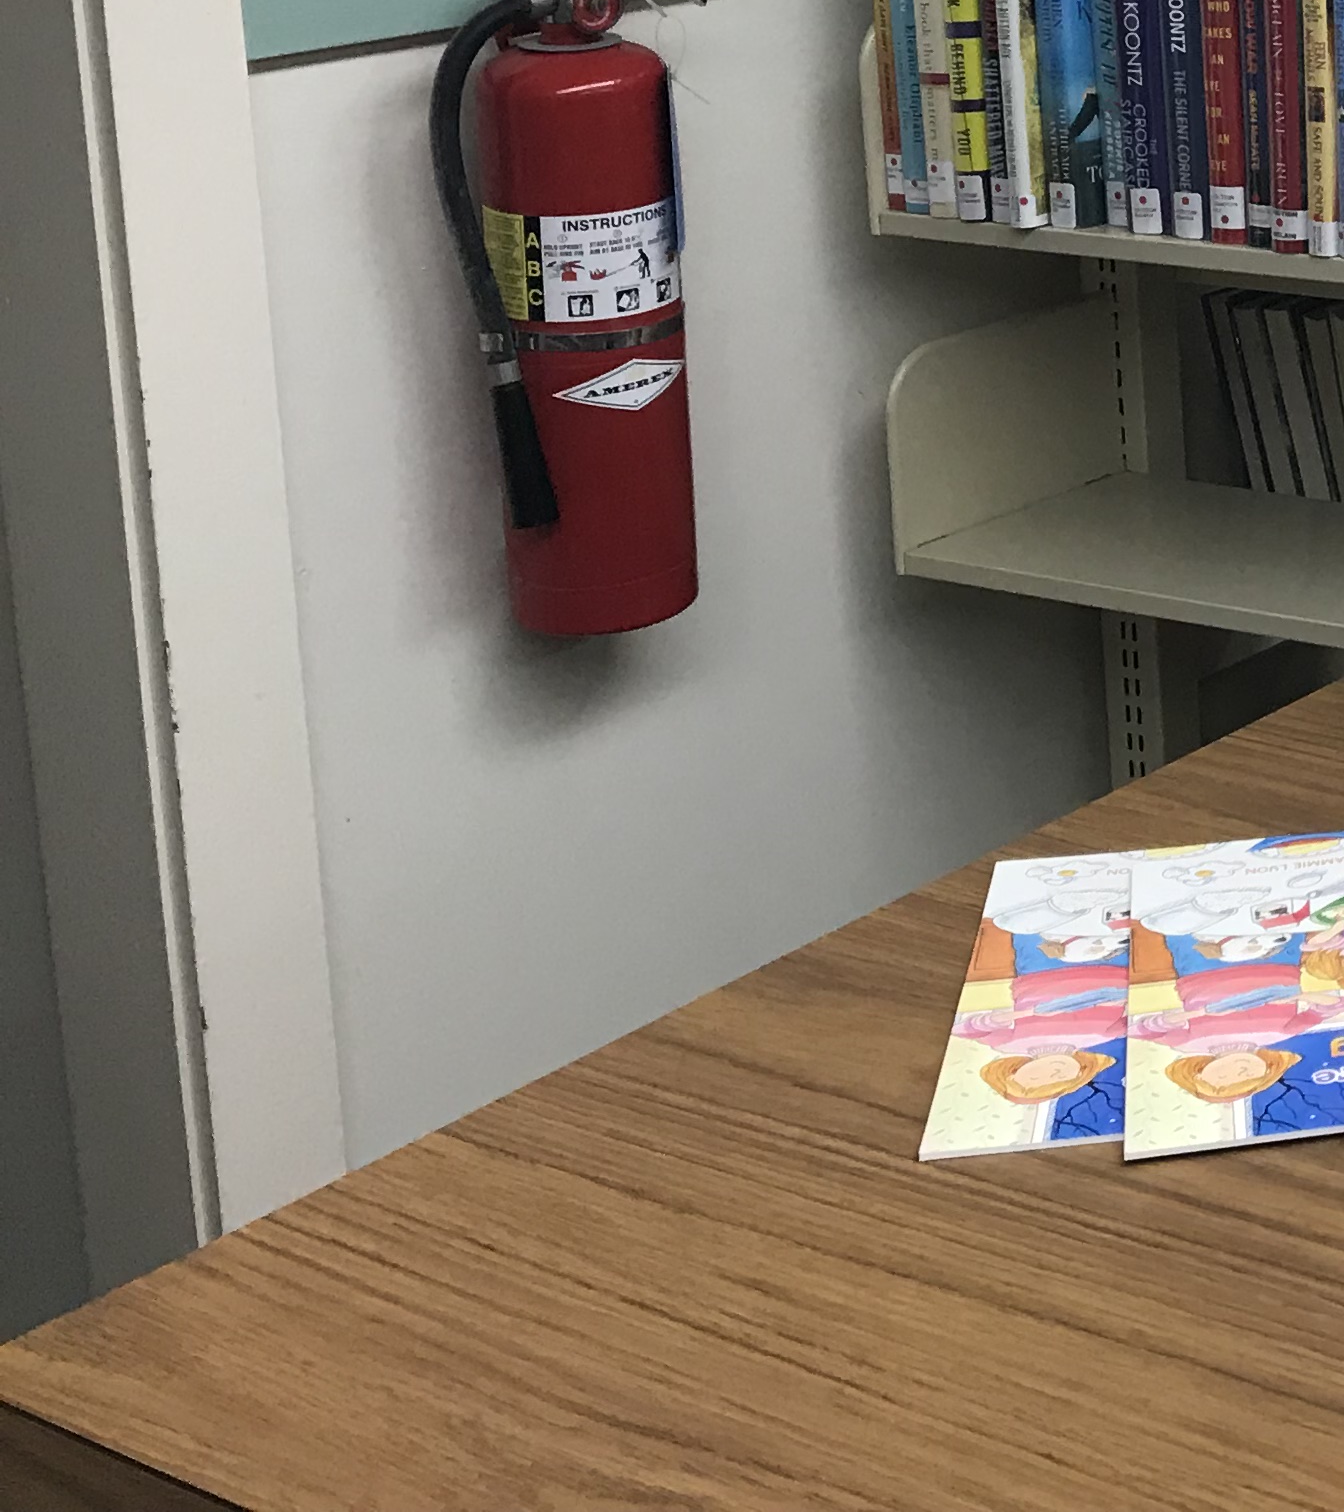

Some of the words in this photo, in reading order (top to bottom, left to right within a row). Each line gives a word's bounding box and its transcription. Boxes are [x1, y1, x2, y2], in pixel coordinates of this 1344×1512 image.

[1124, 2, 1143, 86] KOONTZ
[951, 44, 968, 96] BEHIND
[957, 128, 970, 156] YOU
[562, 205, 667, 233] INSTRUCTIONS
[526, 232, 540, 249] A
[527, 261, 541, 277] B
[528, 288, 544, 306] C
[583, 368, 674, 398] AMEREX
